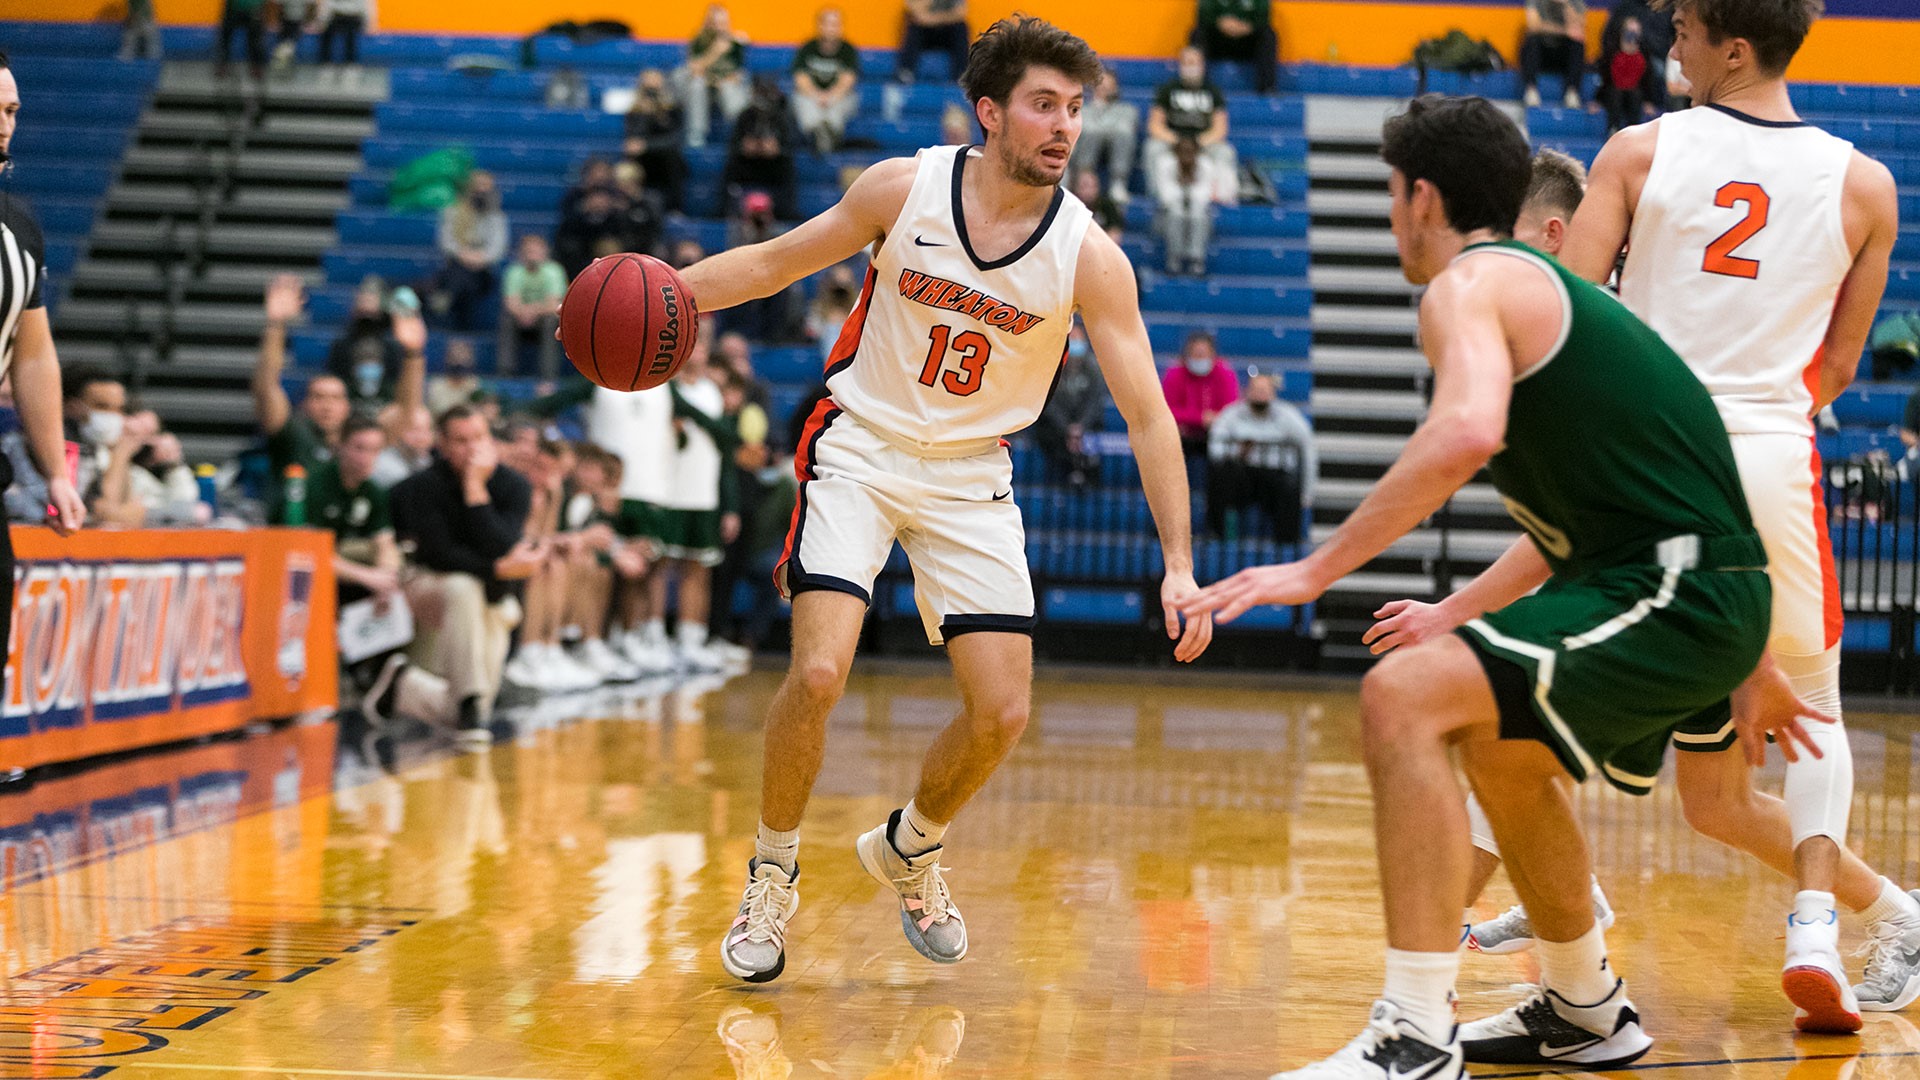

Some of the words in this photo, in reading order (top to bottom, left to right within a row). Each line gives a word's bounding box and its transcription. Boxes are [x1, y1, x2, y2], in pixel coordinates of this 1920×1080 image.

[1701, 180, 1771, 280] 2
[647, 285, 680, 377] Wilson
[898, 267, 1046, 336] WHEATON
[918, 323, 992, 397] 13
